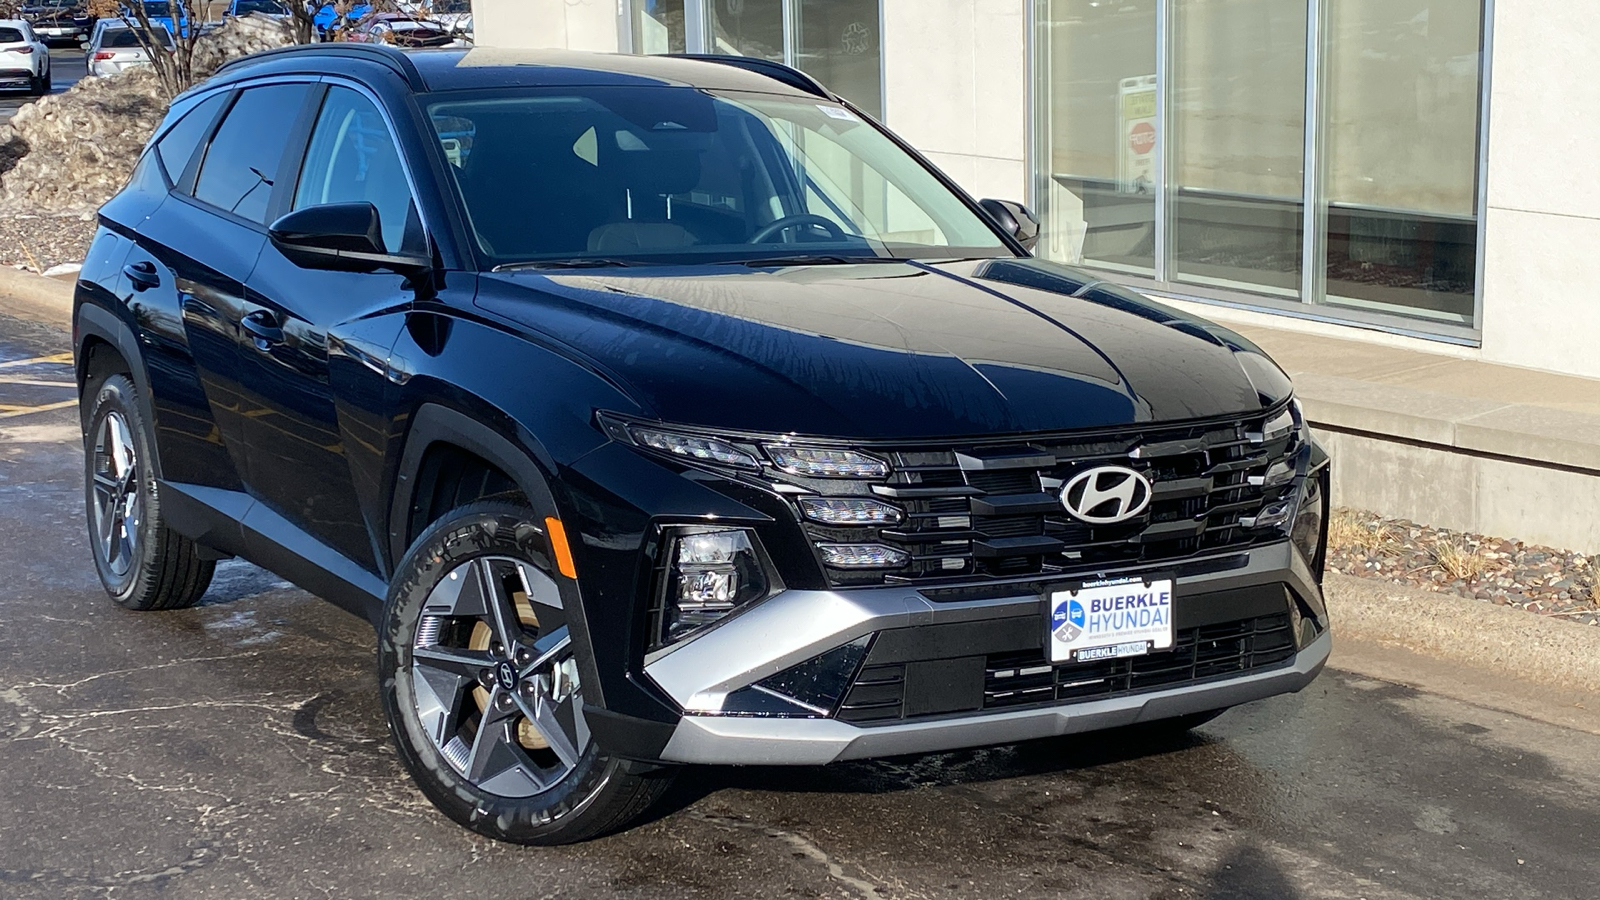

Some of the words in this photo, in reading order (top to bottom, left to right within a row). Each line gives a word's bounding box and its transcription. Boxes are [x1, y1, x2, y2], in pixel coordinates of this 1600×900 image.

[1082, 576, 1142, 588] buerklehyundai.com
[1090, 592, 1170, 613] BUERKLE
[1089, 607, 1169, 633] HYUNDAI
[1080, 646, 1117, 660] BUERKLE
[1117, 641, 1146, 654] HYUNDAI
